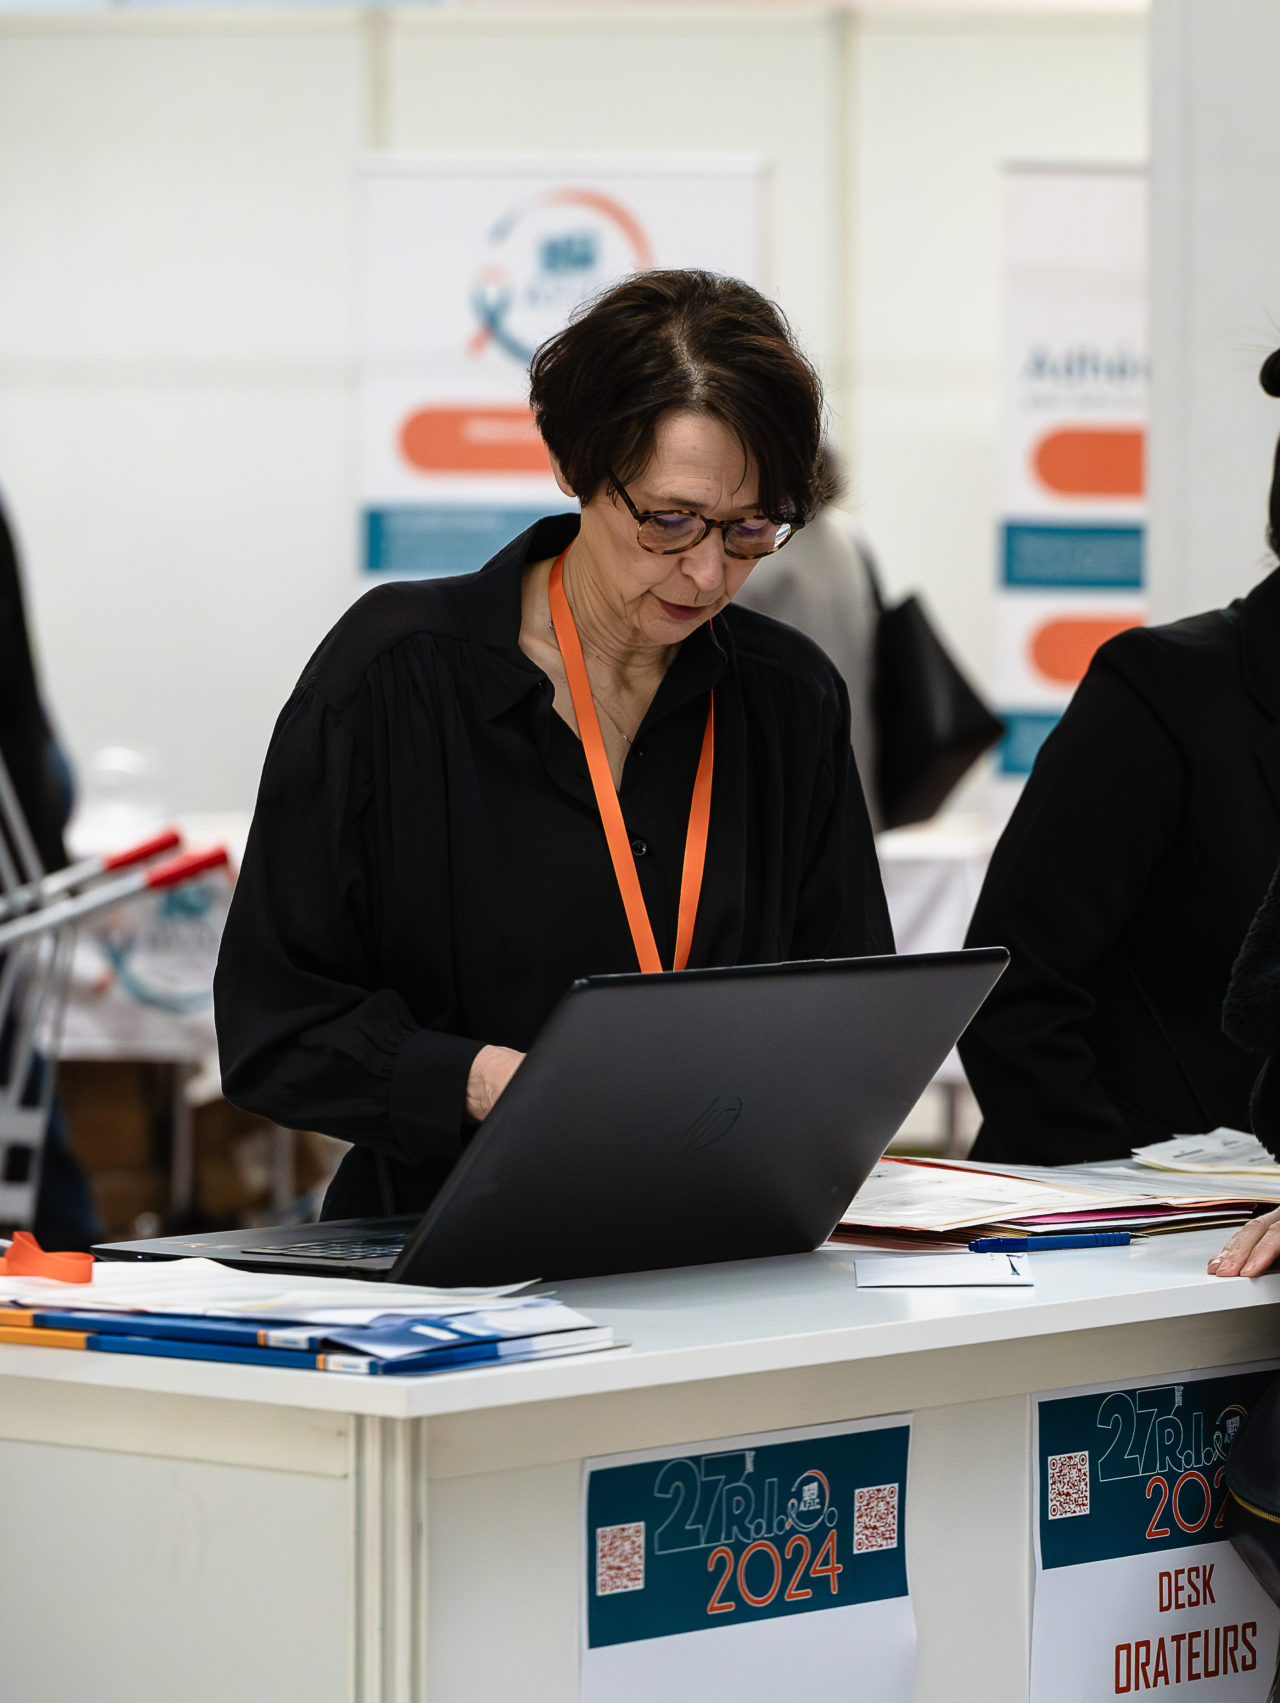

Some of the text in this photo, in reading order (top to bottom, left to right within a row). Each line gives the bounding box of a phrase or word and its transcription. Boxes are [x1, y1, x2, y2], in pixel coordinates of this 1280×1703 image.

[1096, 1385, 1178, 1482] 27
[653, 1450, 750, 1555] 27
[706, 1528, 844, 1615] 2024
[1158, 1563, 1216, 1613] DESK
[1114, 1621, 1257, 1695] ORATEURS
